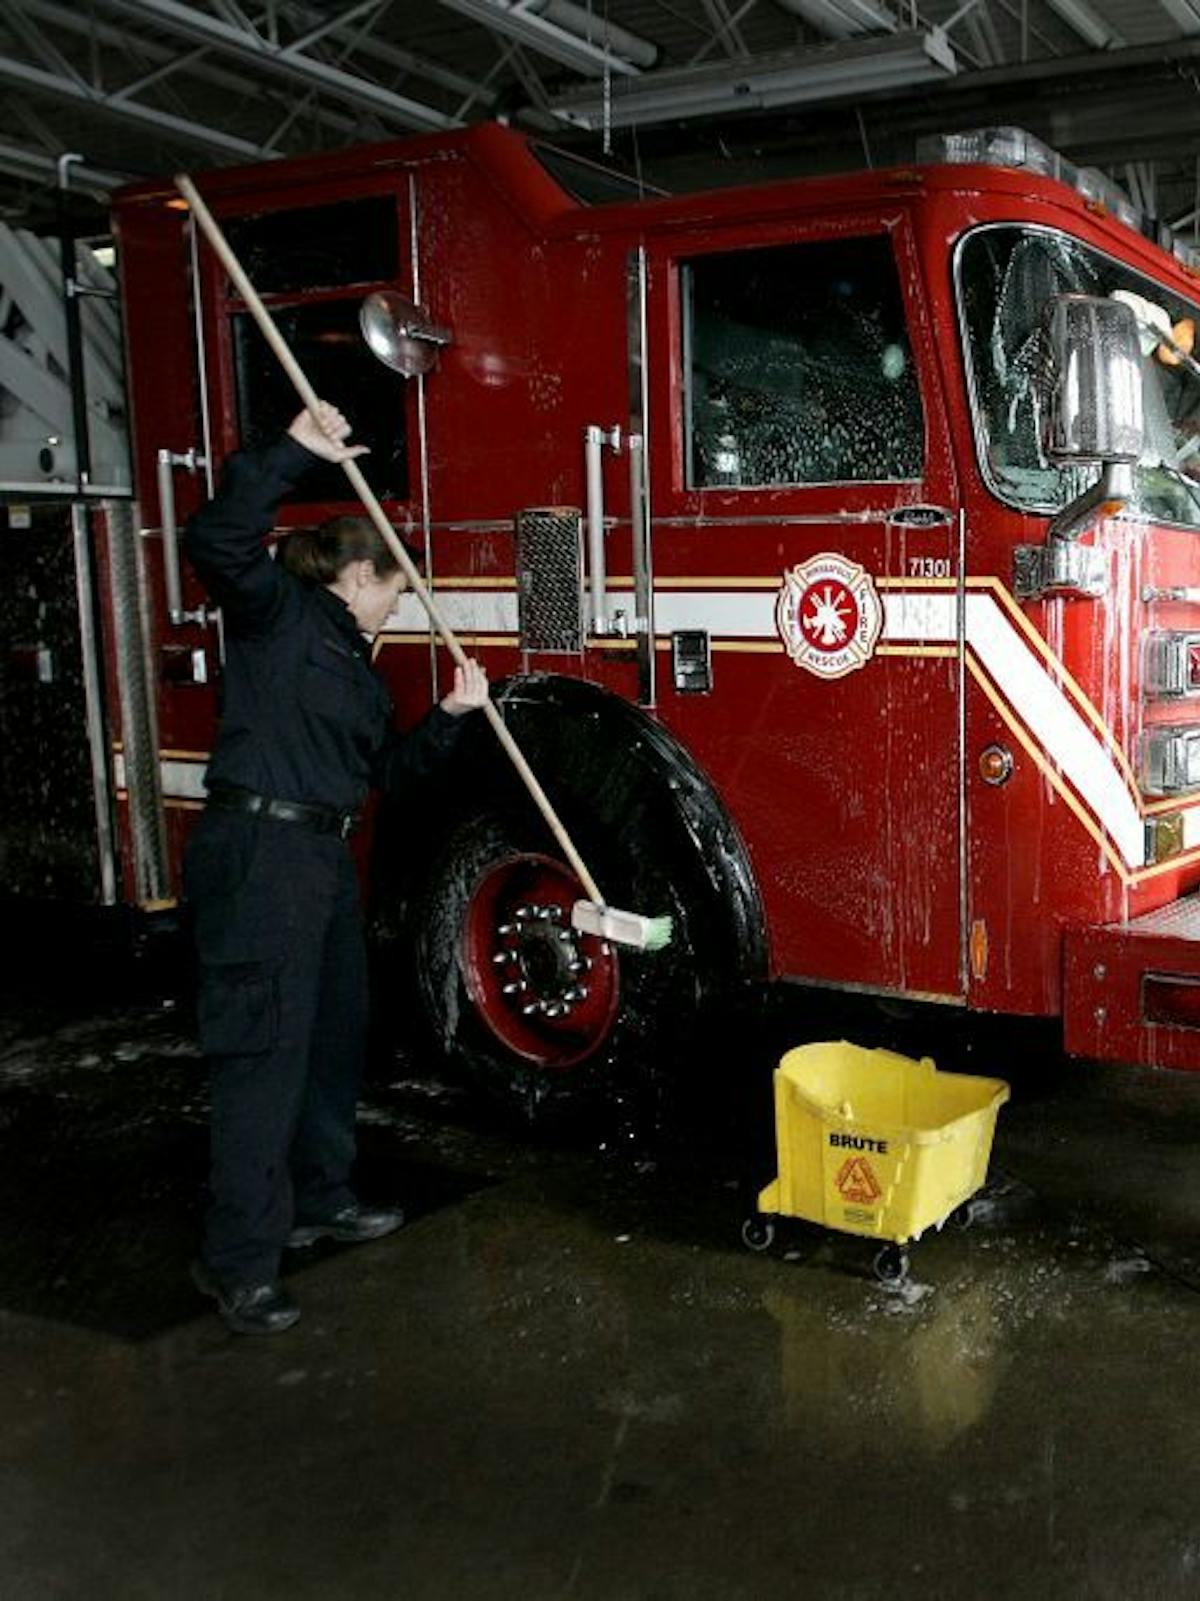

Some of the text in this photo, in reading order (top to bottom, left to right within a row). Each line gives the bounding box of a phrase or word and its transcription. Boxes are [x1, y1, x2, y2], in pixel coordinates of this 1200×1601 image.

[909, 558, 951, 577] 71301
[860, 588, 868, 643] FIRE
[830, 1134, 888, 1153] BRUTE
